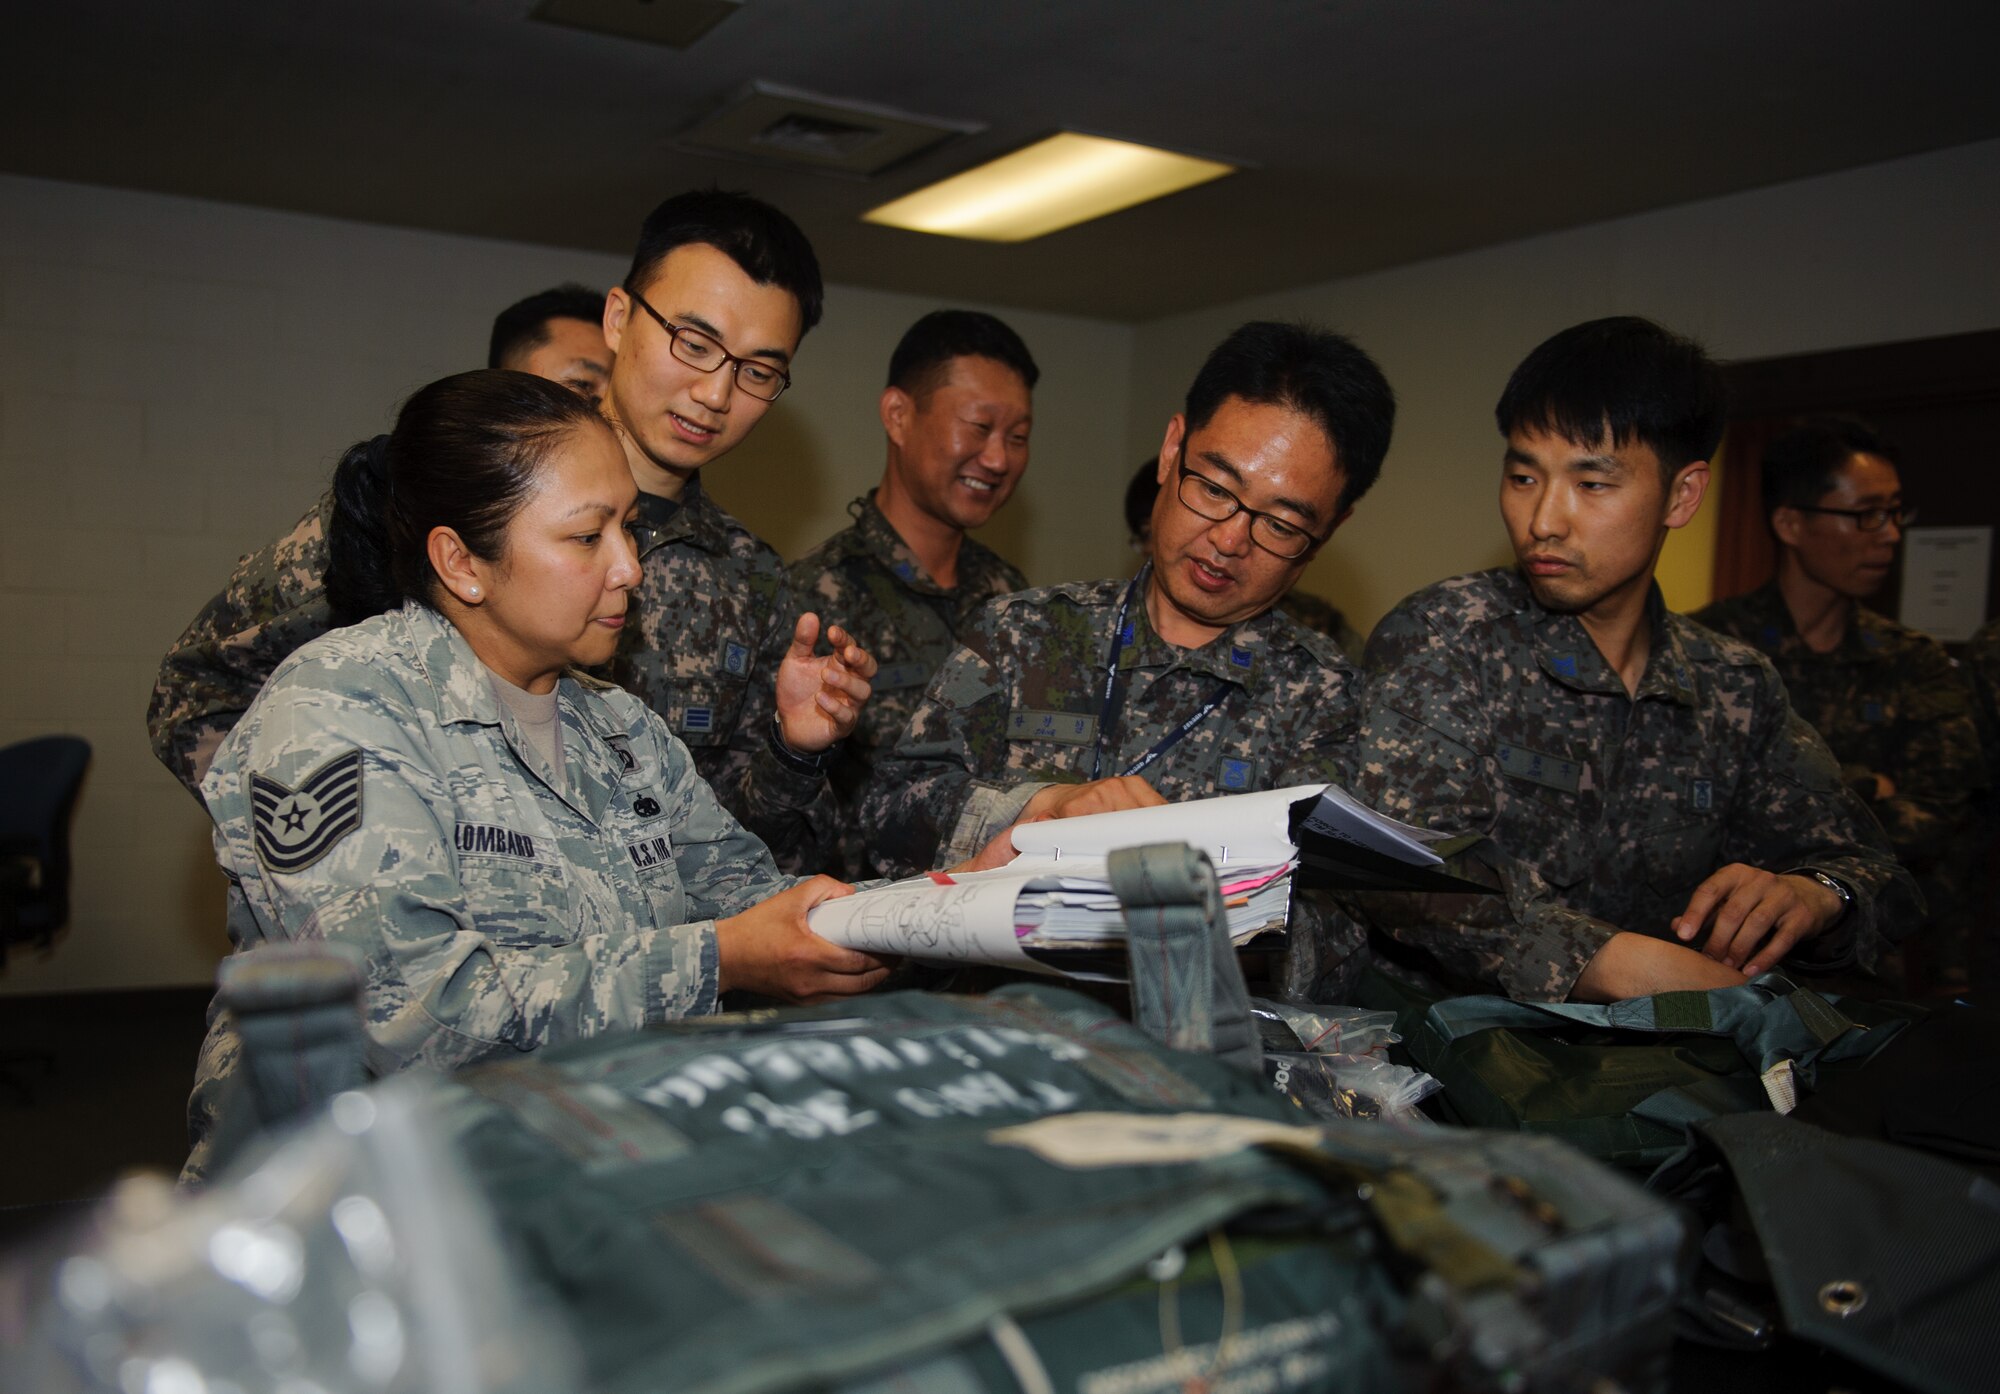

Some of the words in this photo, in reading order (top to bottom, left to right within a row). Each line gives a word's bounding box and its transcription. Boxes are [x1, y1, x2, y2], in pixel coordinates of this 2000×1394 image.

[454, 824, 536, 858] LOMBARD
[628, 842, 657, 867] U.S.
[651, 837, 671, 861] AIR
